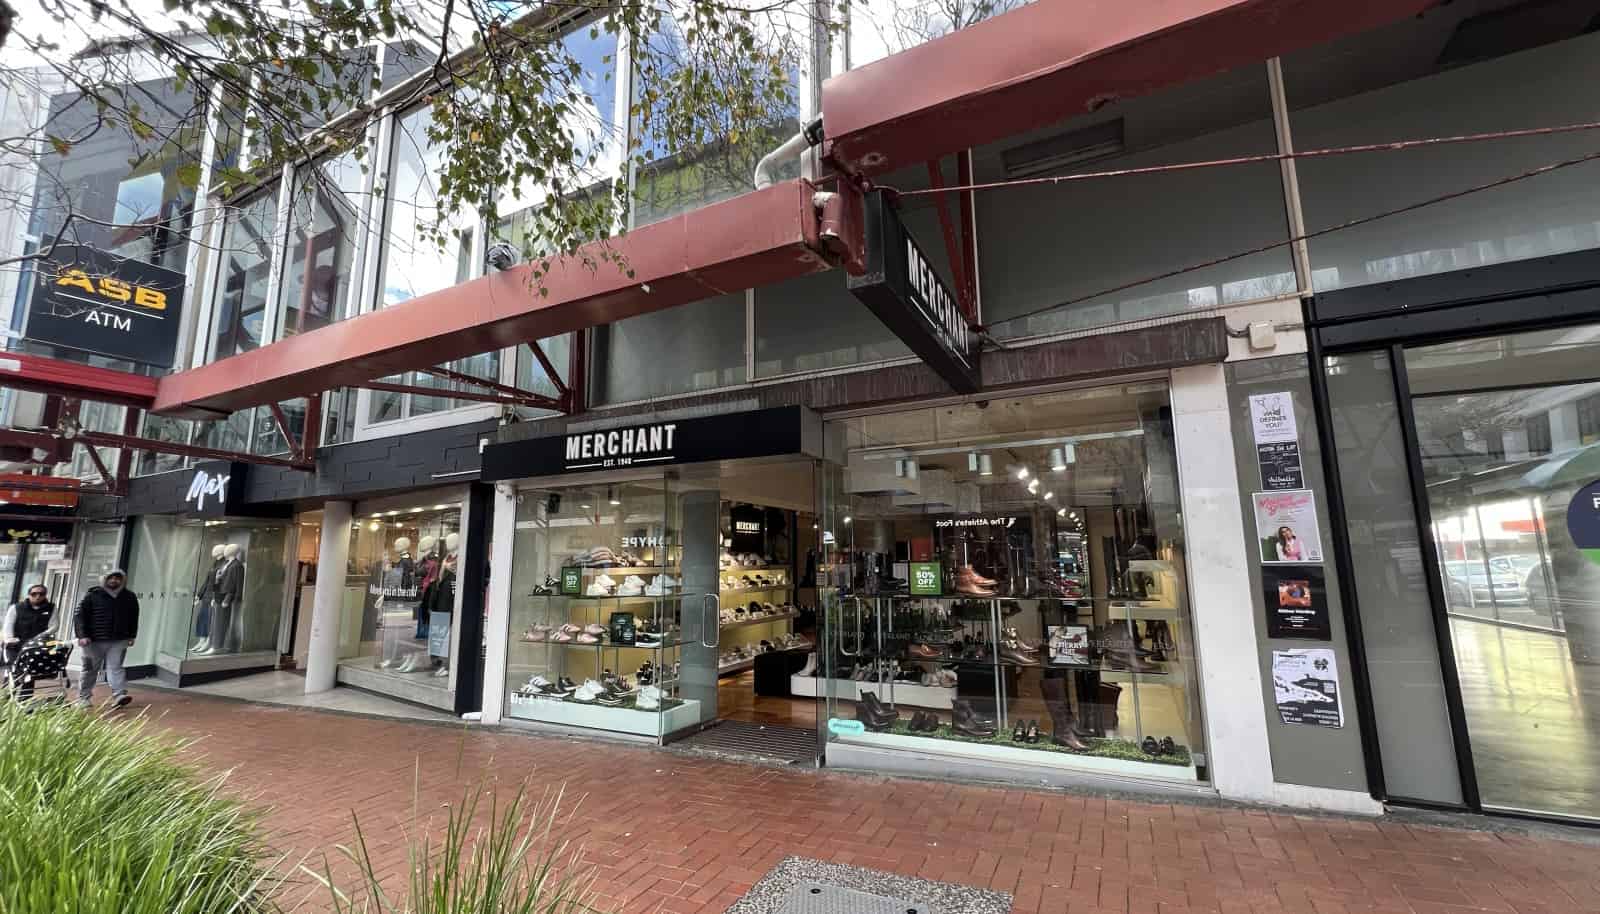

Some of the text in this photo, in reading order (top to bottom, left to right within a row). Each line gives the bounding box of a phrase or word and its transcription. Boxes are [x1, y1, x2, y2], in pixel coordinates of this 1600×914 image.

[56, 269, 168, 311] ASB
[906, 239, 969, 357] MERCHANT
[85, 311, 132, 332] ATM
[565, 424, 677, 460] MERCHANT
[185, 470, 231, 511] Max
[735, 521, 761, 531] MERCHANT
